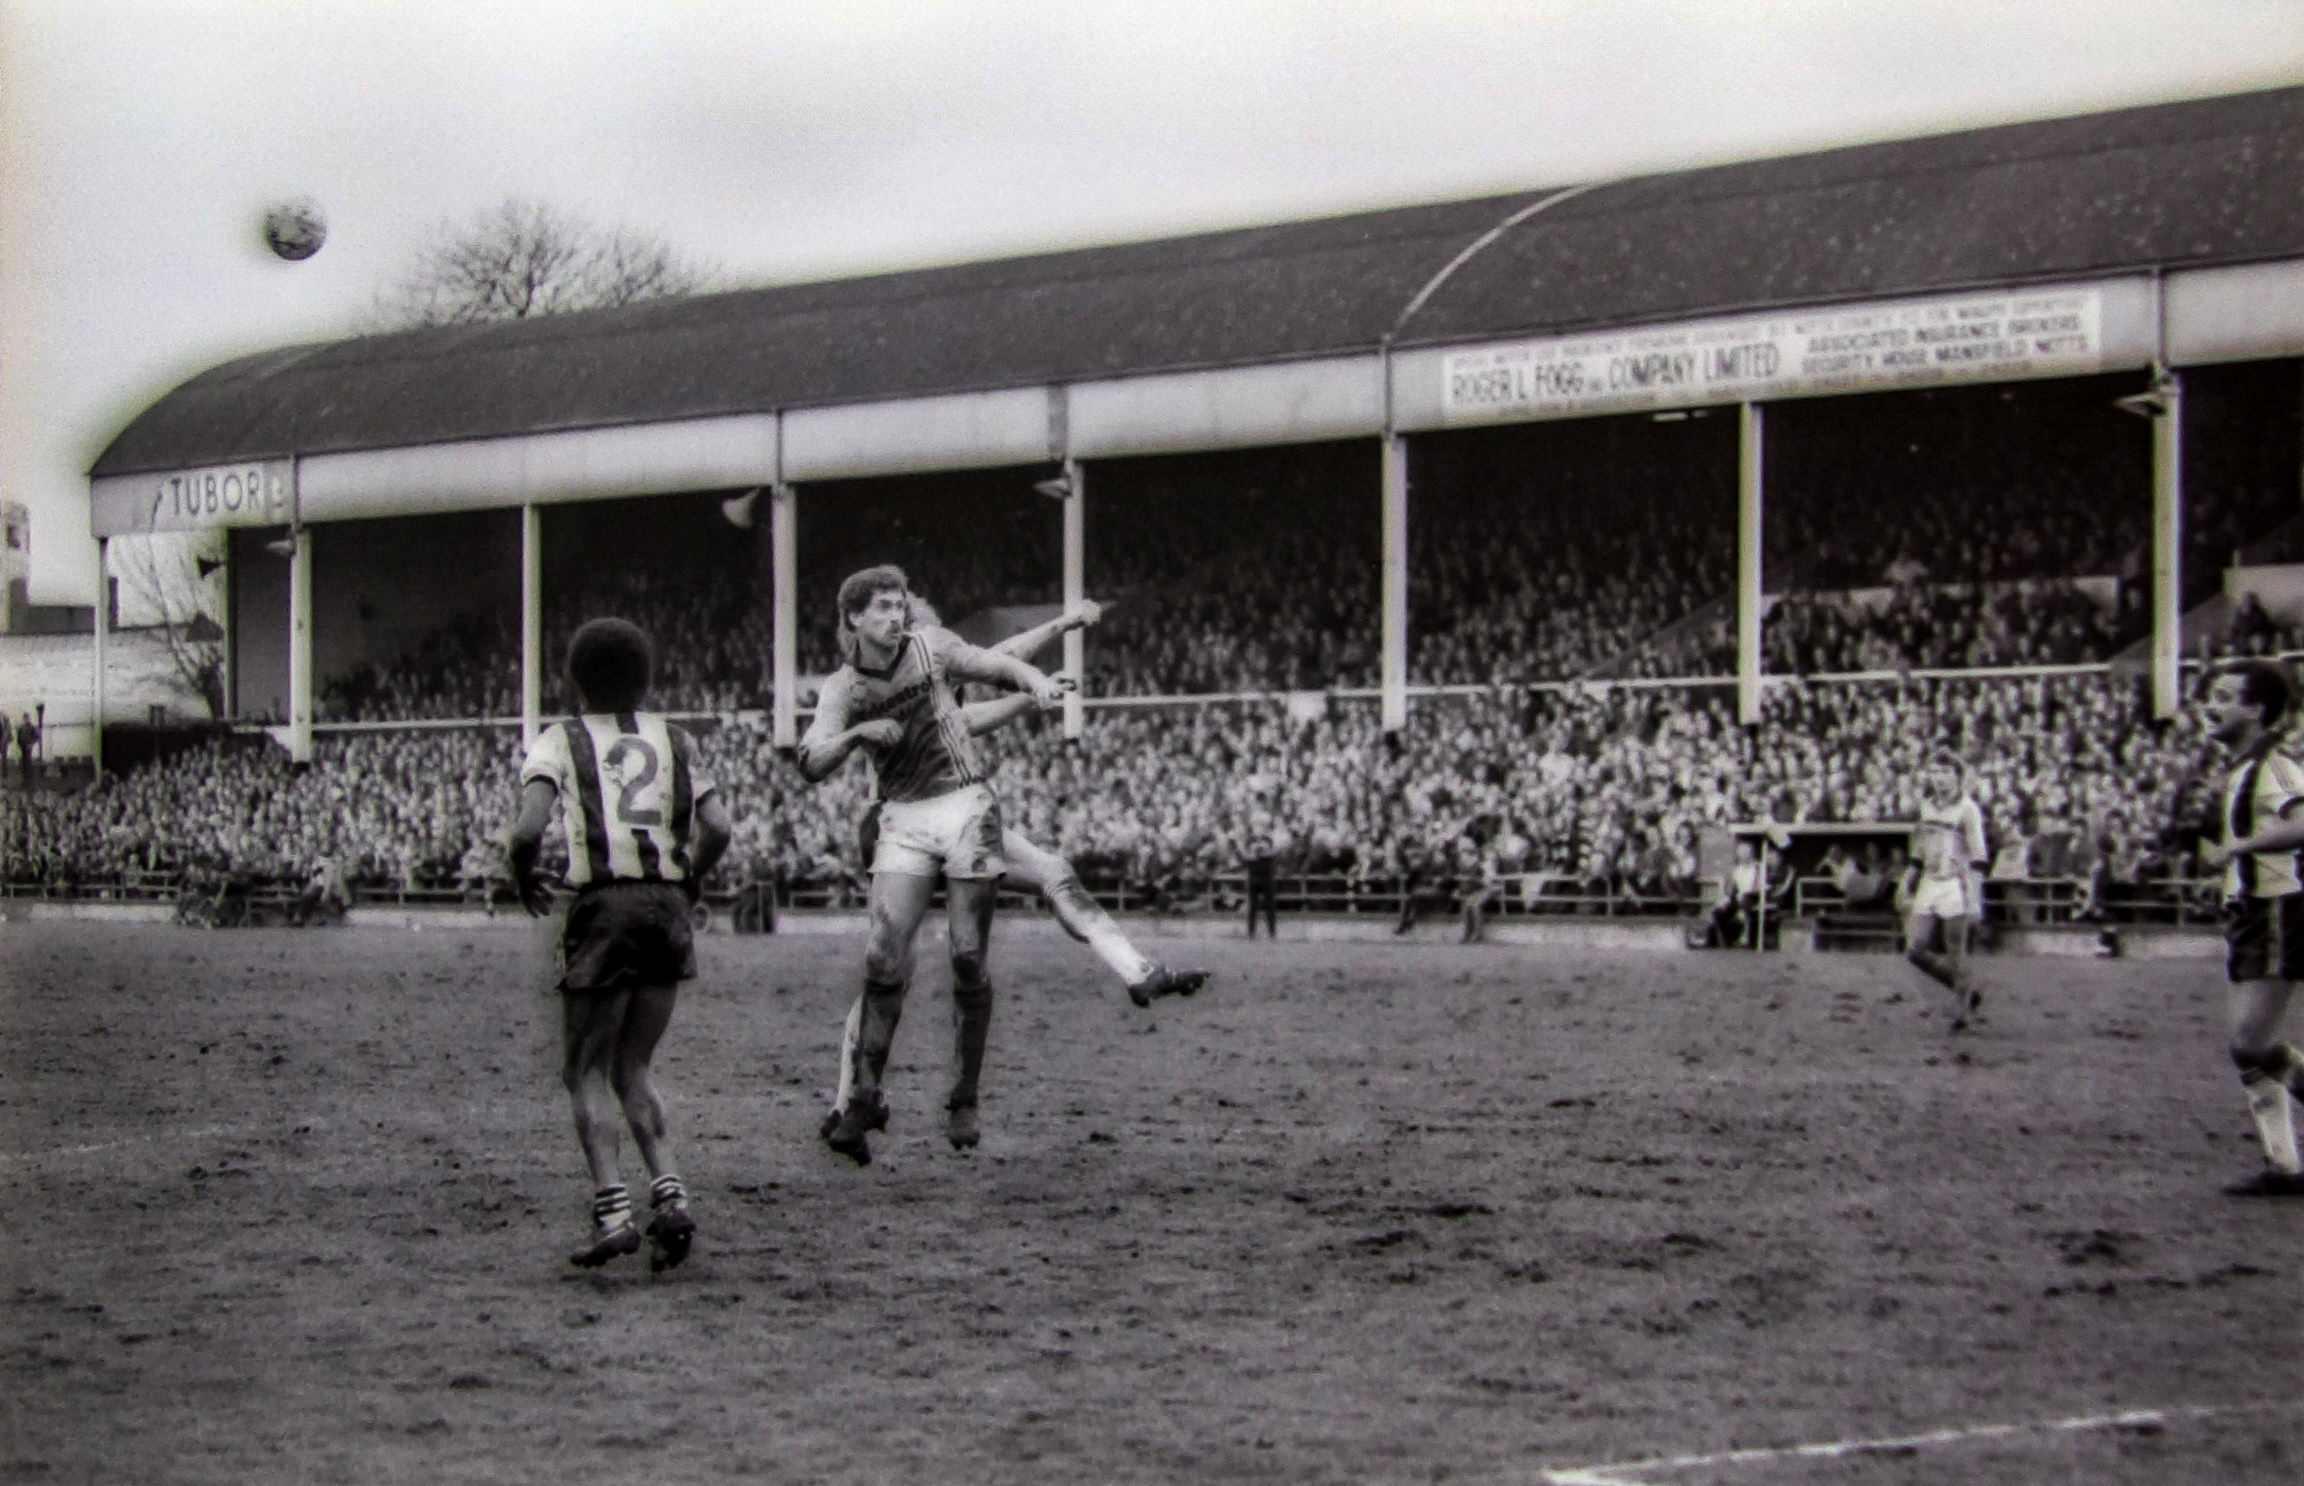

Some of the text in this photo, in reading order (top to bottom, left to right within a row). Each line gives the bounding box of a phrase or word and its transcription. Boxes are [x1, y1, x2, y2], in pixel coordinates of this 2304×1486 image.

[1533, 359, 1584, 397] FOGG
[1607, 352, 1695, 391] COMPANY
[1703, 344, 1781, 381] LIMITED
[604, 736, 662, 826] 2
